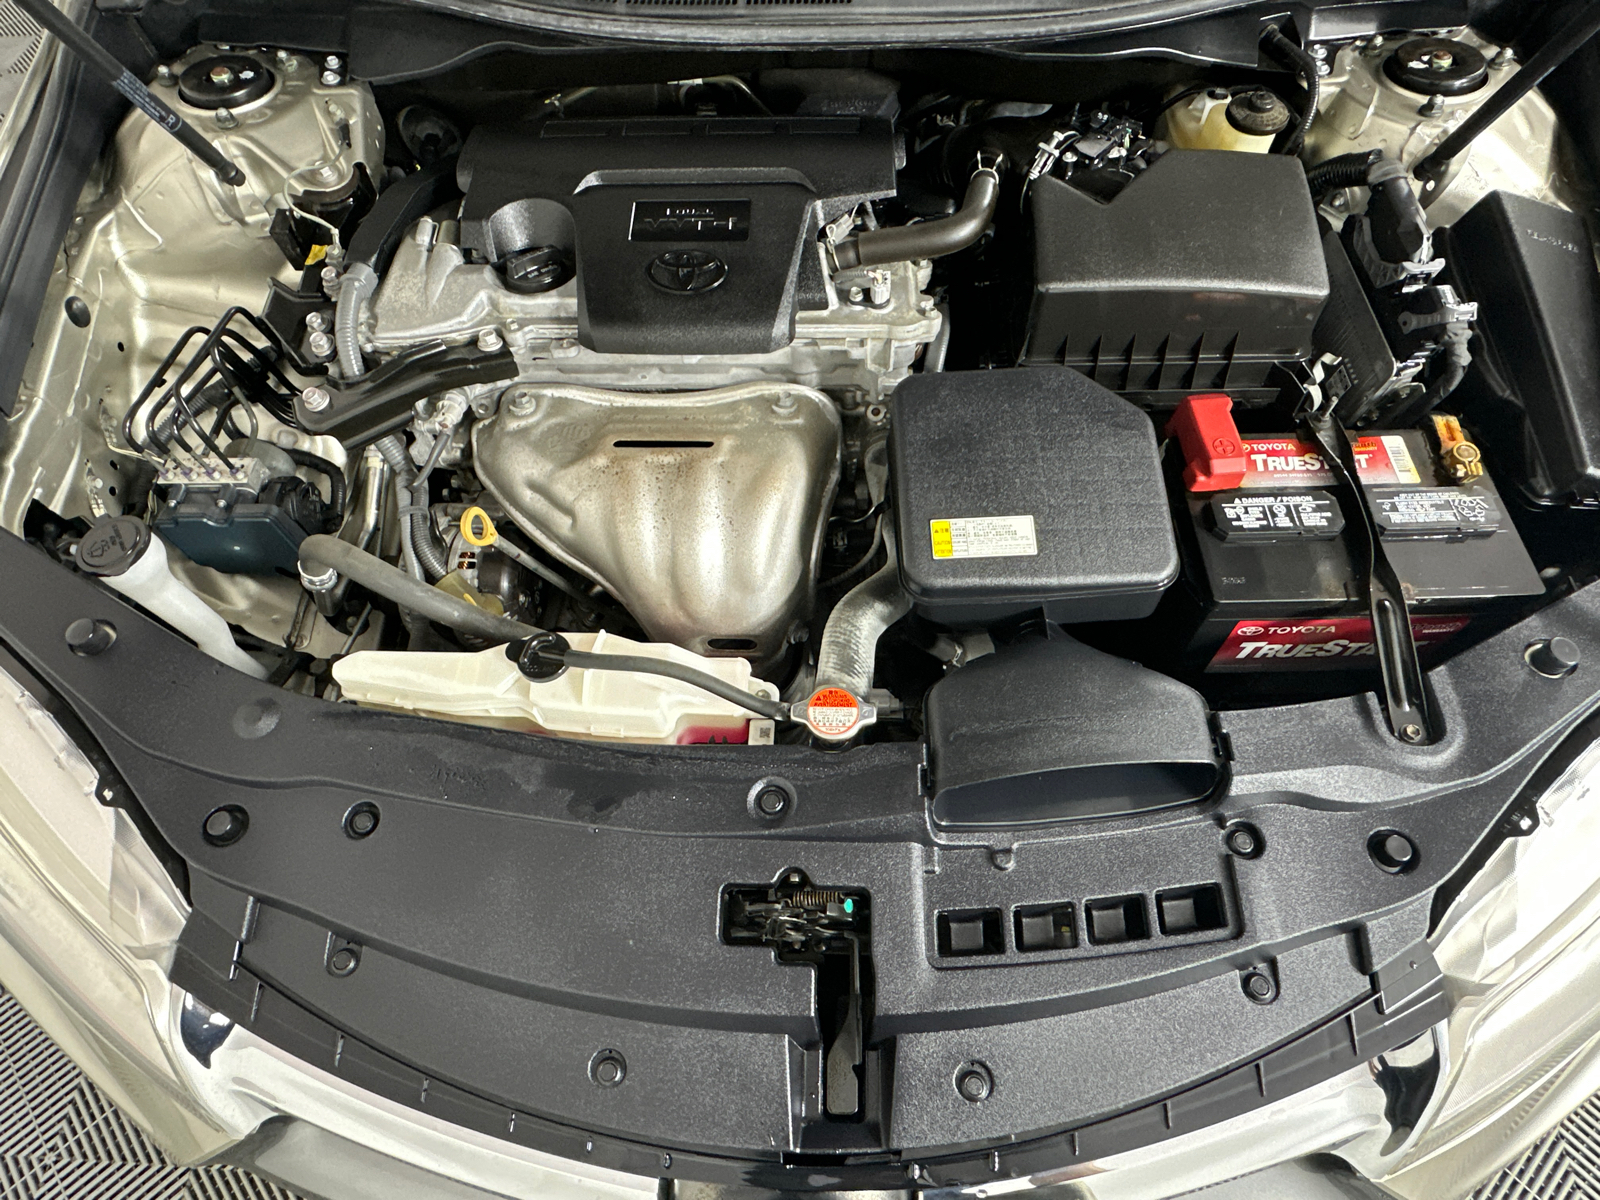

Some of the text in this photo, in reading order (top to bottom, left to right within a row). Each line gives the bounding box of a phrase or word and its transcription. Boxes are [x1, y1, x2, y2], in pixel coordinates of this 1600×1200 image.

[167, 114, 176, 127] R
[1251, 443, 1296, 451] TOYOTA
[1282, 495, 1313, 503] POISON
[1268, 625, 1336, 635] TOYOTA
